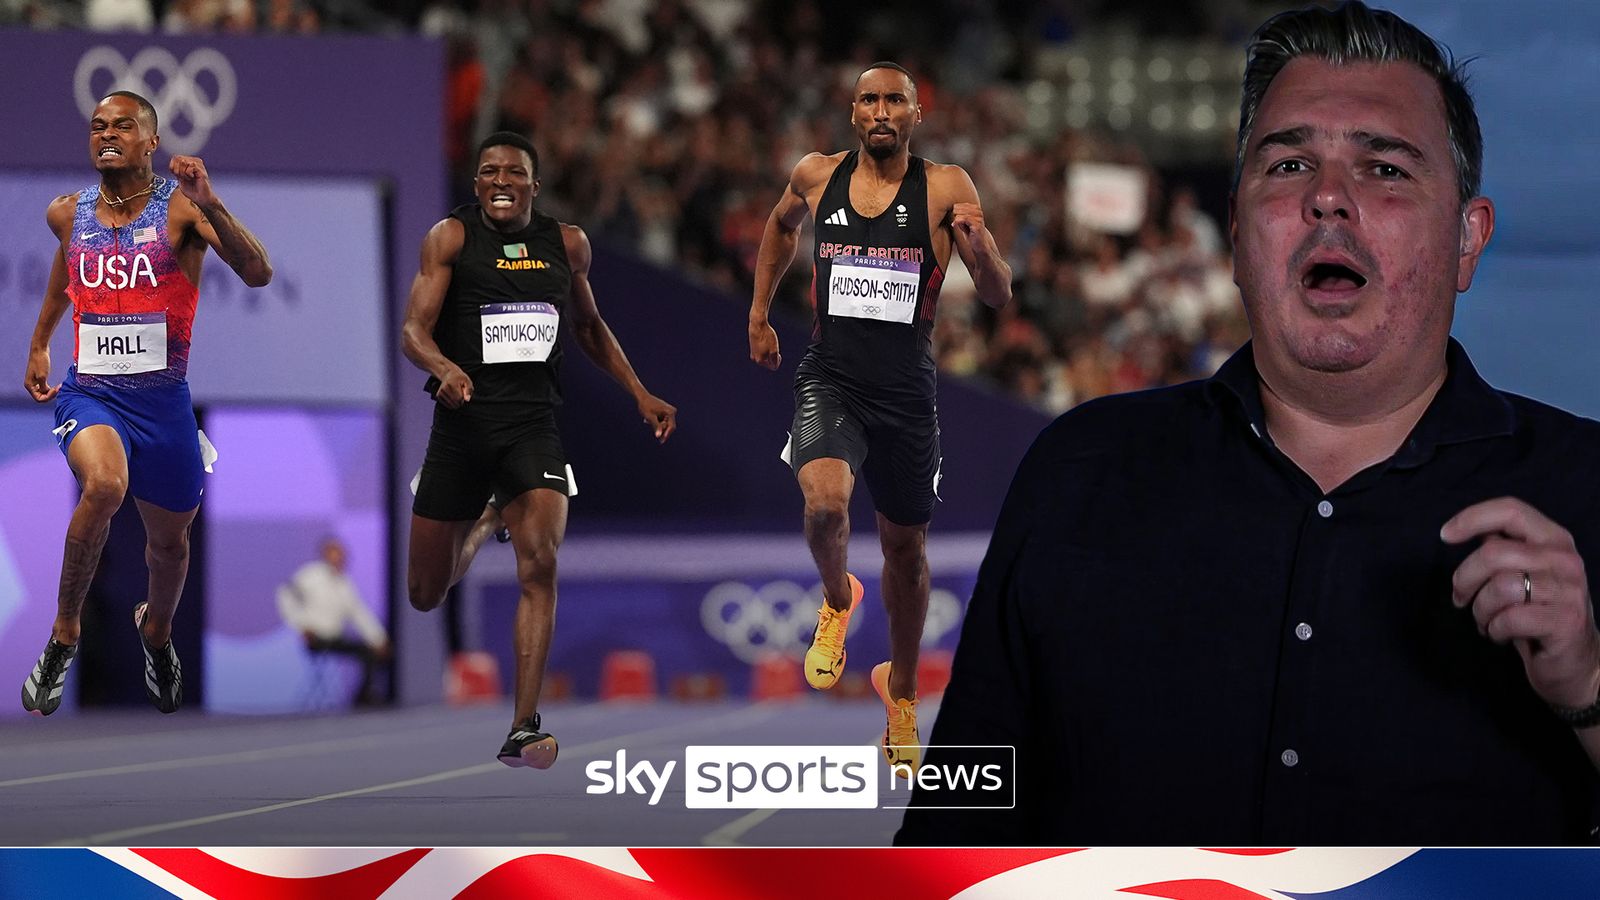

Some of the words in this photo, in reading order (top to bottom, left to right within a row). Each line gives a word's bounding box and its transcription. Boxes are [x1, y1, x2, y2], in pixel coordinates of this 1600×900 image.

[819, 242, 862, 258] GREAT
[867, 247, 924, 264] BRITAIN
[854, 258, 876, 266] PARIS
[80, 252, 158, 290] USA
[832, 276, 916, 303] HUDSON-SMITH
[502, 304, 524, 312] PARIS
[97, 335, 147, 355] HALL
